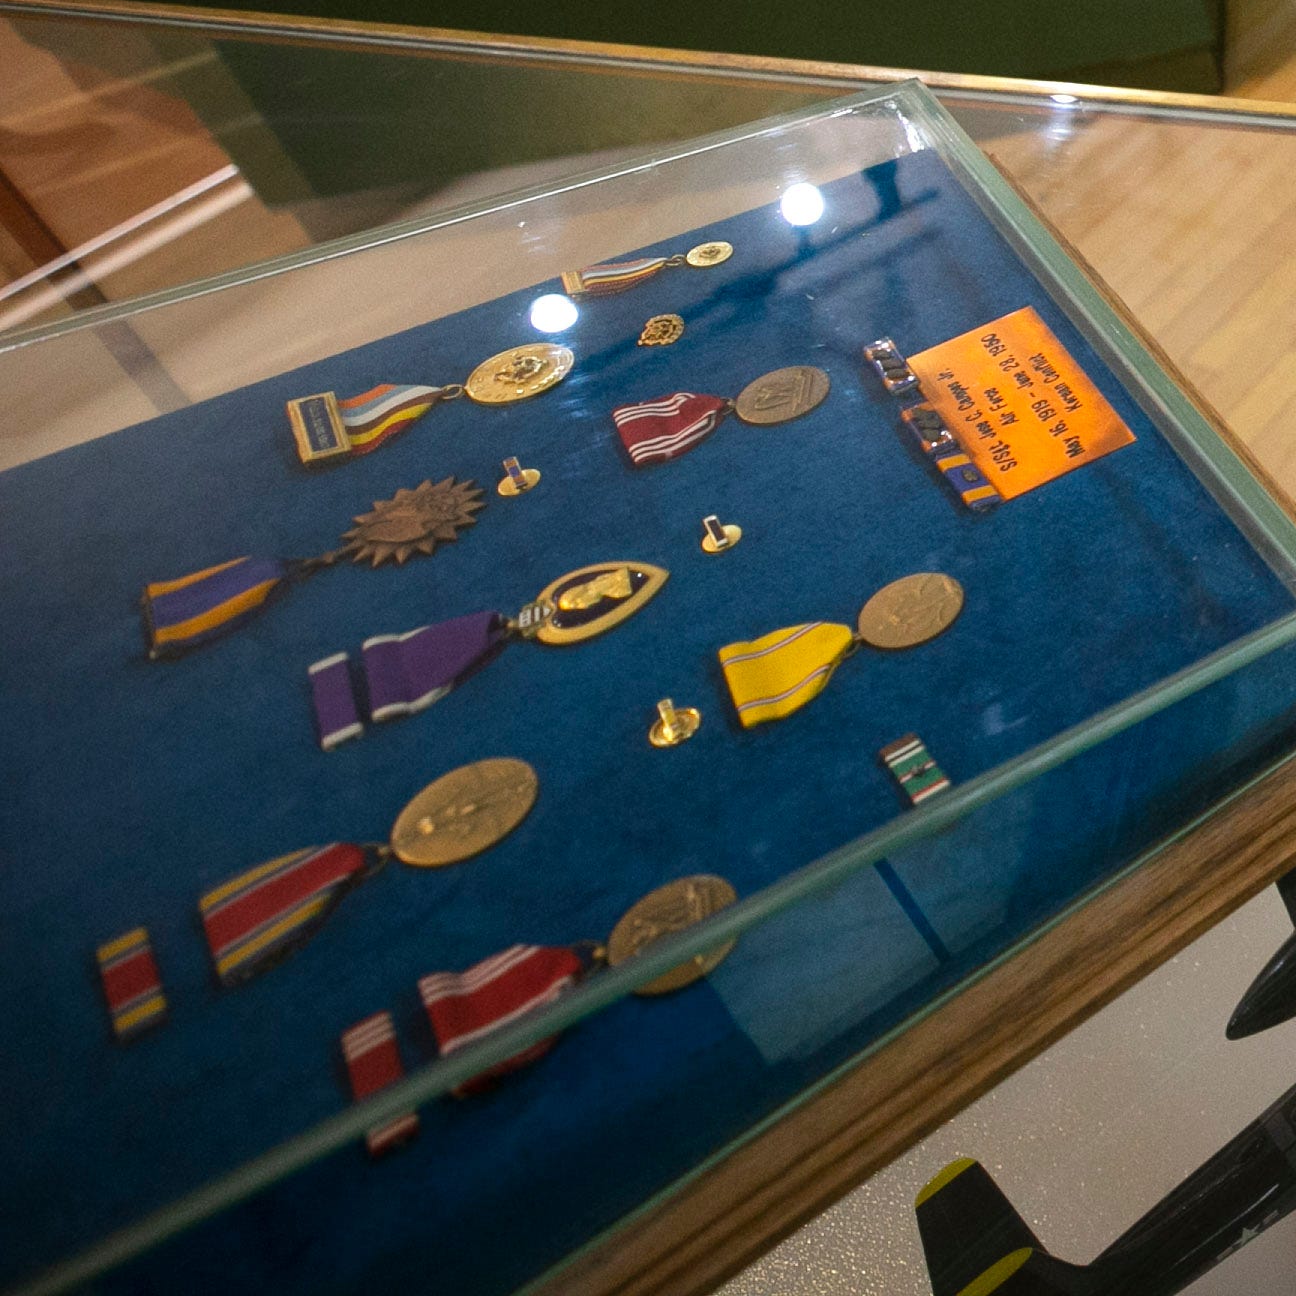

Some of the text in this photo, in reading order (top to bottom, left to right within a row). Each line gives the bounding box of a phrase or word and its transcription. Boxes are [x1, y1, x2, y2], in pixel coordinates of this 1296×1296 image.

[980, 333, 1006, 356] 1950
[1013, 370, 1033, 389] June
[1028, 352, 1082, 412] Korean Conflict
[947, 381, 975, 410] Campos
[983, 387, 1019, 425] Air Force
[1031, 399, 1056, 421] 1919
[1063, 435, 1084, 457] May
